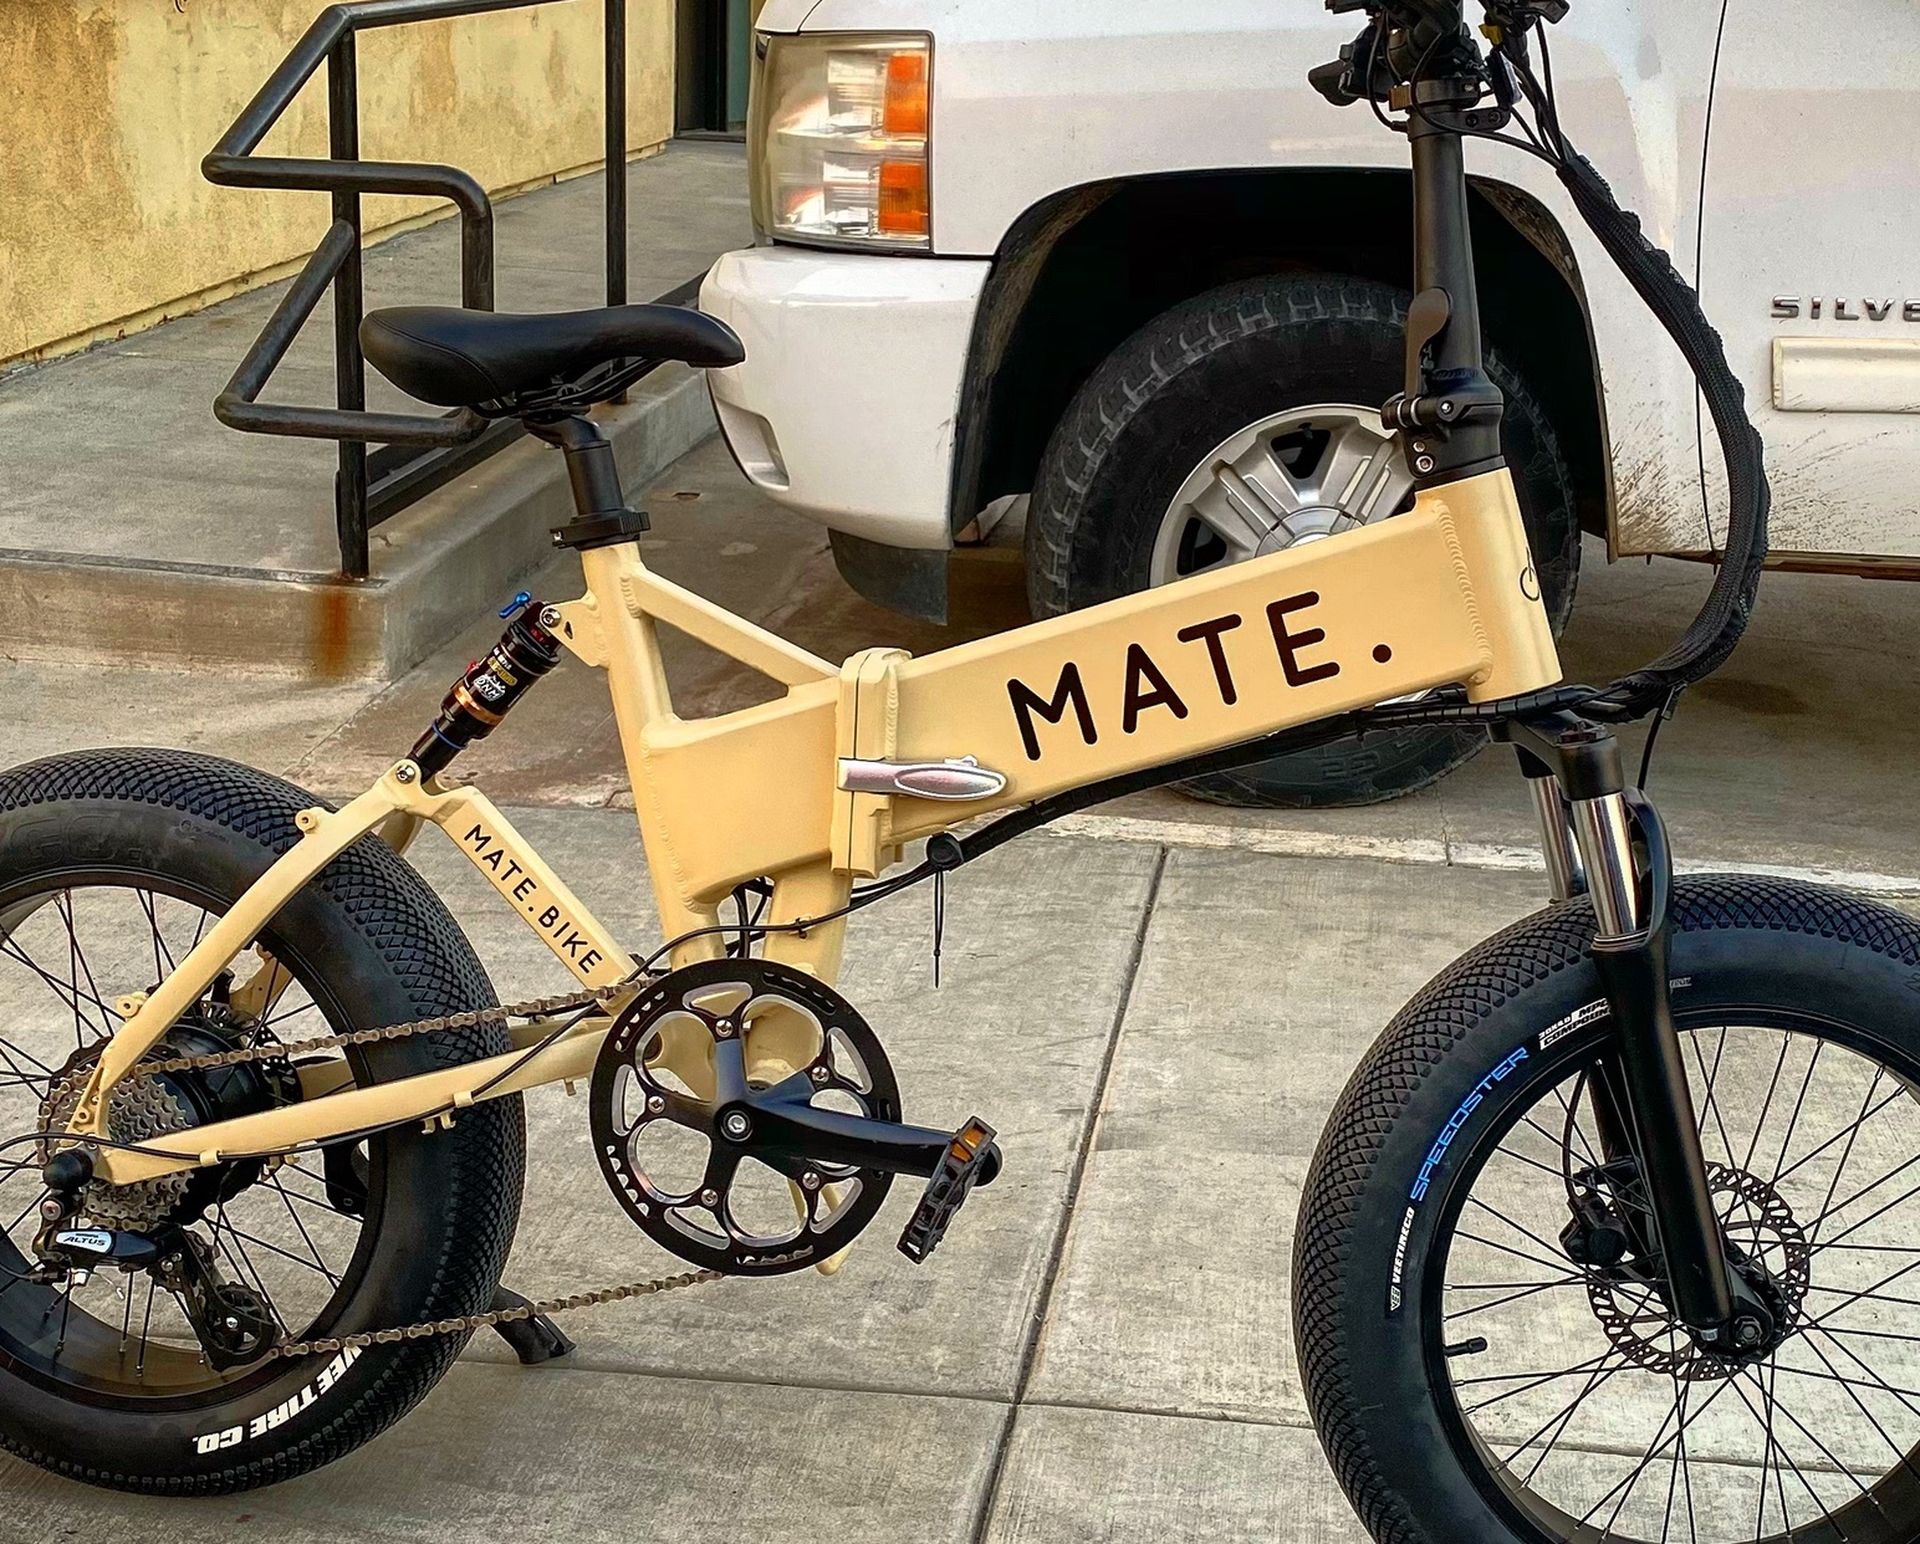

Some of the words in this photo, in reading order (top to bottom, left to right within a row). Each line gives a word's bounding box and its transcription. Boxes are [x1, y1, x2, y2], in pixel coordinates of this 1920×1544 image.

[1770, 295, 1920, 322] SILVE
[1007, 591, 1392, 761] MATE.
[464, 824, 603, 974] MATE.BIKE
[1544, 1007, 1610, 1046] COMPOUN
[1410, 1047, 1530, 1201] SPEEDSTER
[63, 1236, 107, 1246] ALTUS
[250, 1385, 318, 1439] TIRE
[192, 1425, 243, 1454] CO.
